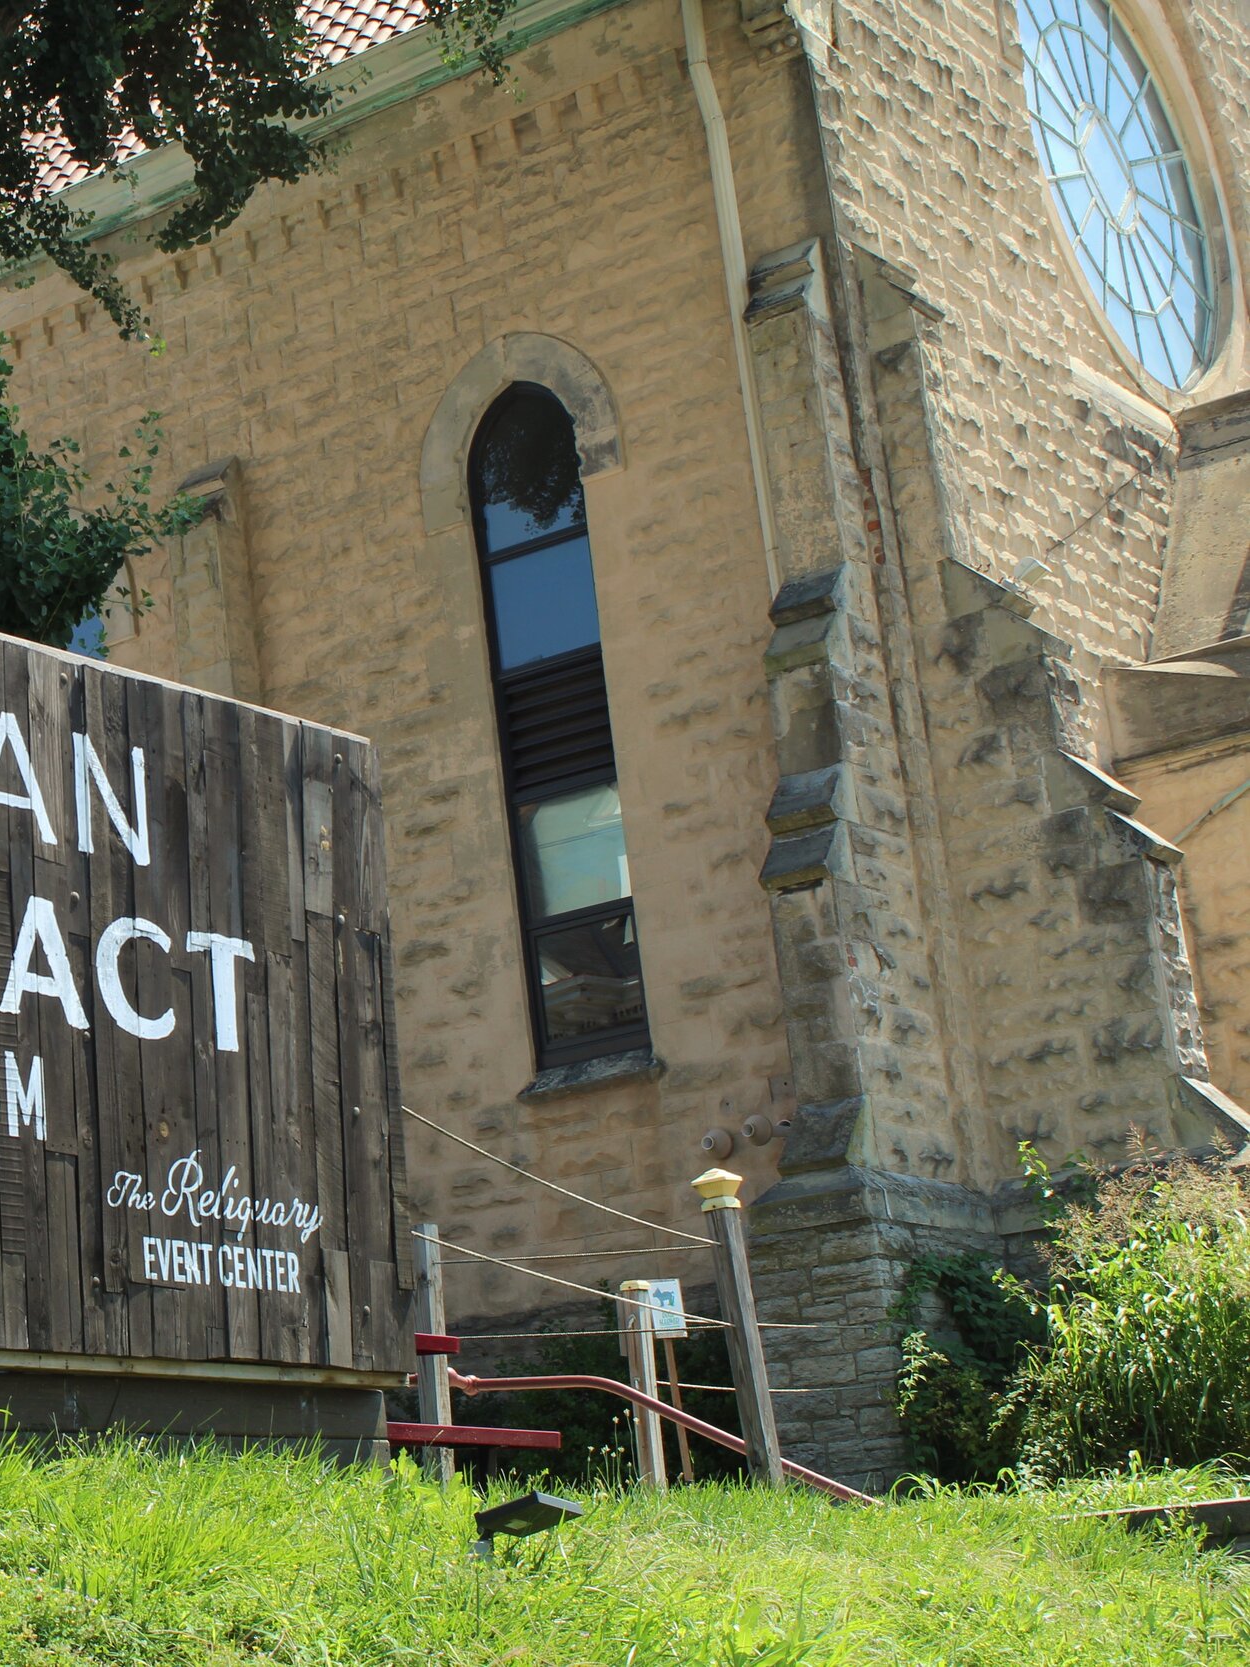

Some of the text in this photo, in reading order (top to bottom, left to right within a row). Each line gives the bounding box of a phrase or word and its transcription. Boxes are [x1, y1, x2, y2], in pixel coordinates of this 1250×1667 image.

[107, 1150, 323, 1243] The Reliquary
[143, 1236, 301, 1293] EVENT CENTER
